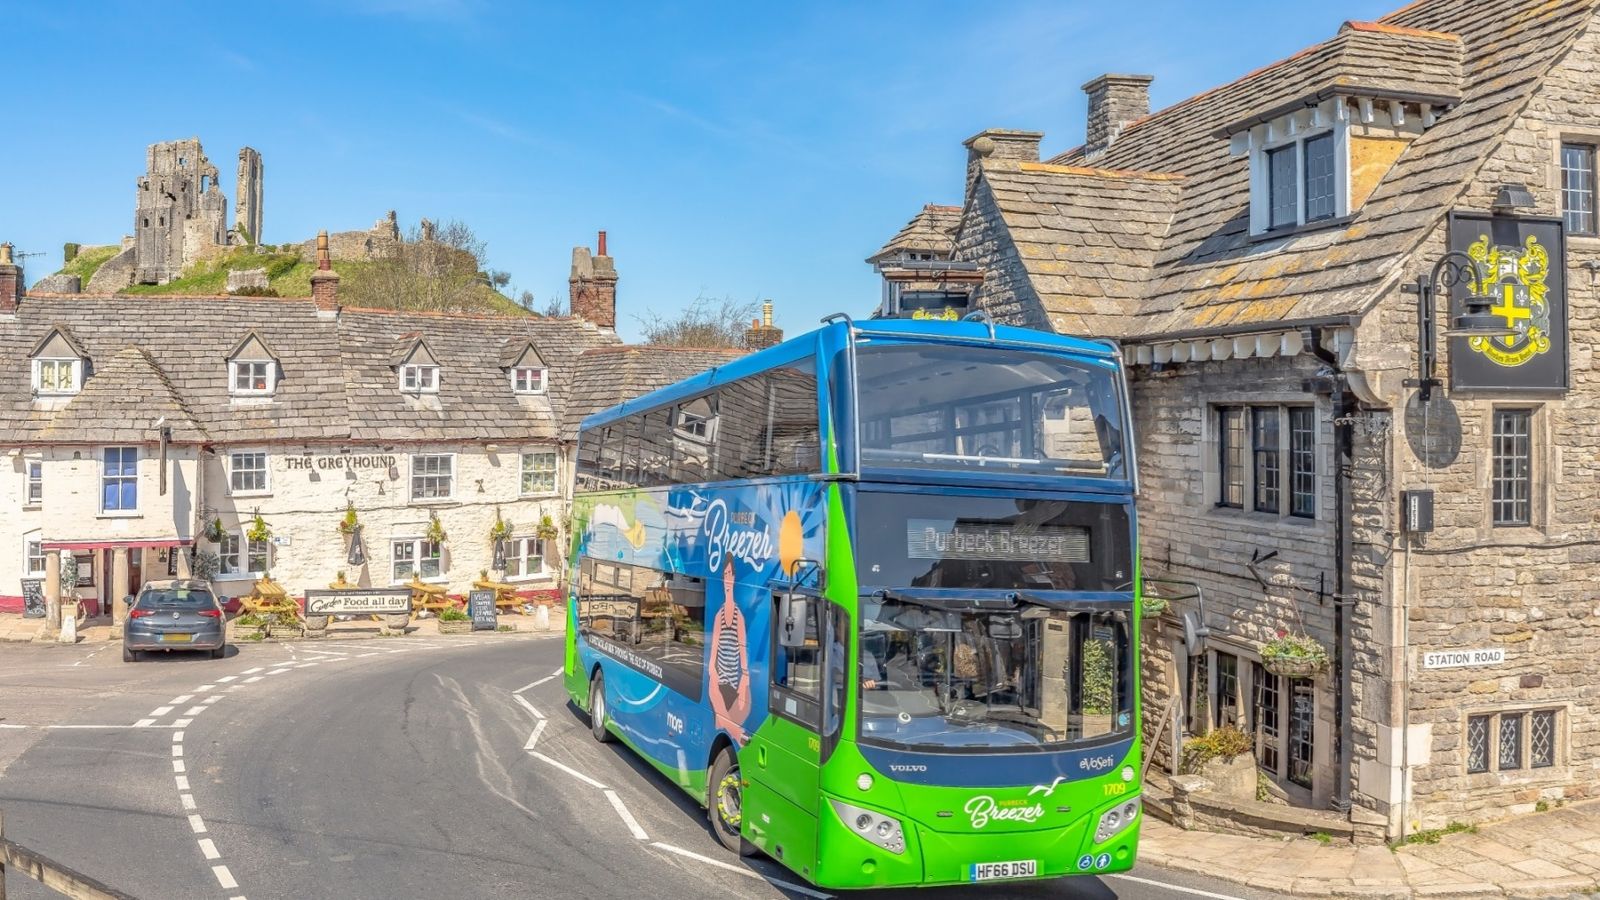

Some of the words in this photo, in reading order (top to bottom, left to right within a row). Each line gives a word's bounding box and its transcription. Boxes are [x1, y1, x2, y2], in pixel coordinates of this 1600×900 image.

[284, 457, 312, 469] THE
[318, 456, 396, 469] GREYHOUND
[704, 498, 773, 573] Breezer
[924, 527, 994, 552] Purbeck
[1000, 530, 1066, 554] Breezer
[311, 596, 342, 613] Garden
[343, 597, 369, 606] Food
[372, 597, 385, 606] all
[388, 597, 407, 608] day
[1428, 653, 1470, 665] STATION
[1474, 651, 1501, 662] ROAD
[667, 711, 683, 734] more
[889, 764, 927, 772] VOLVO
[1103, 782, 1126, 796] 1709
[999, 799, 1028, 807] PURBECK
[964, 795, 1045, 829] Breezer
[977, 863, 1009, 879] HF66
[1011, 861, 1035, 876] DSU
